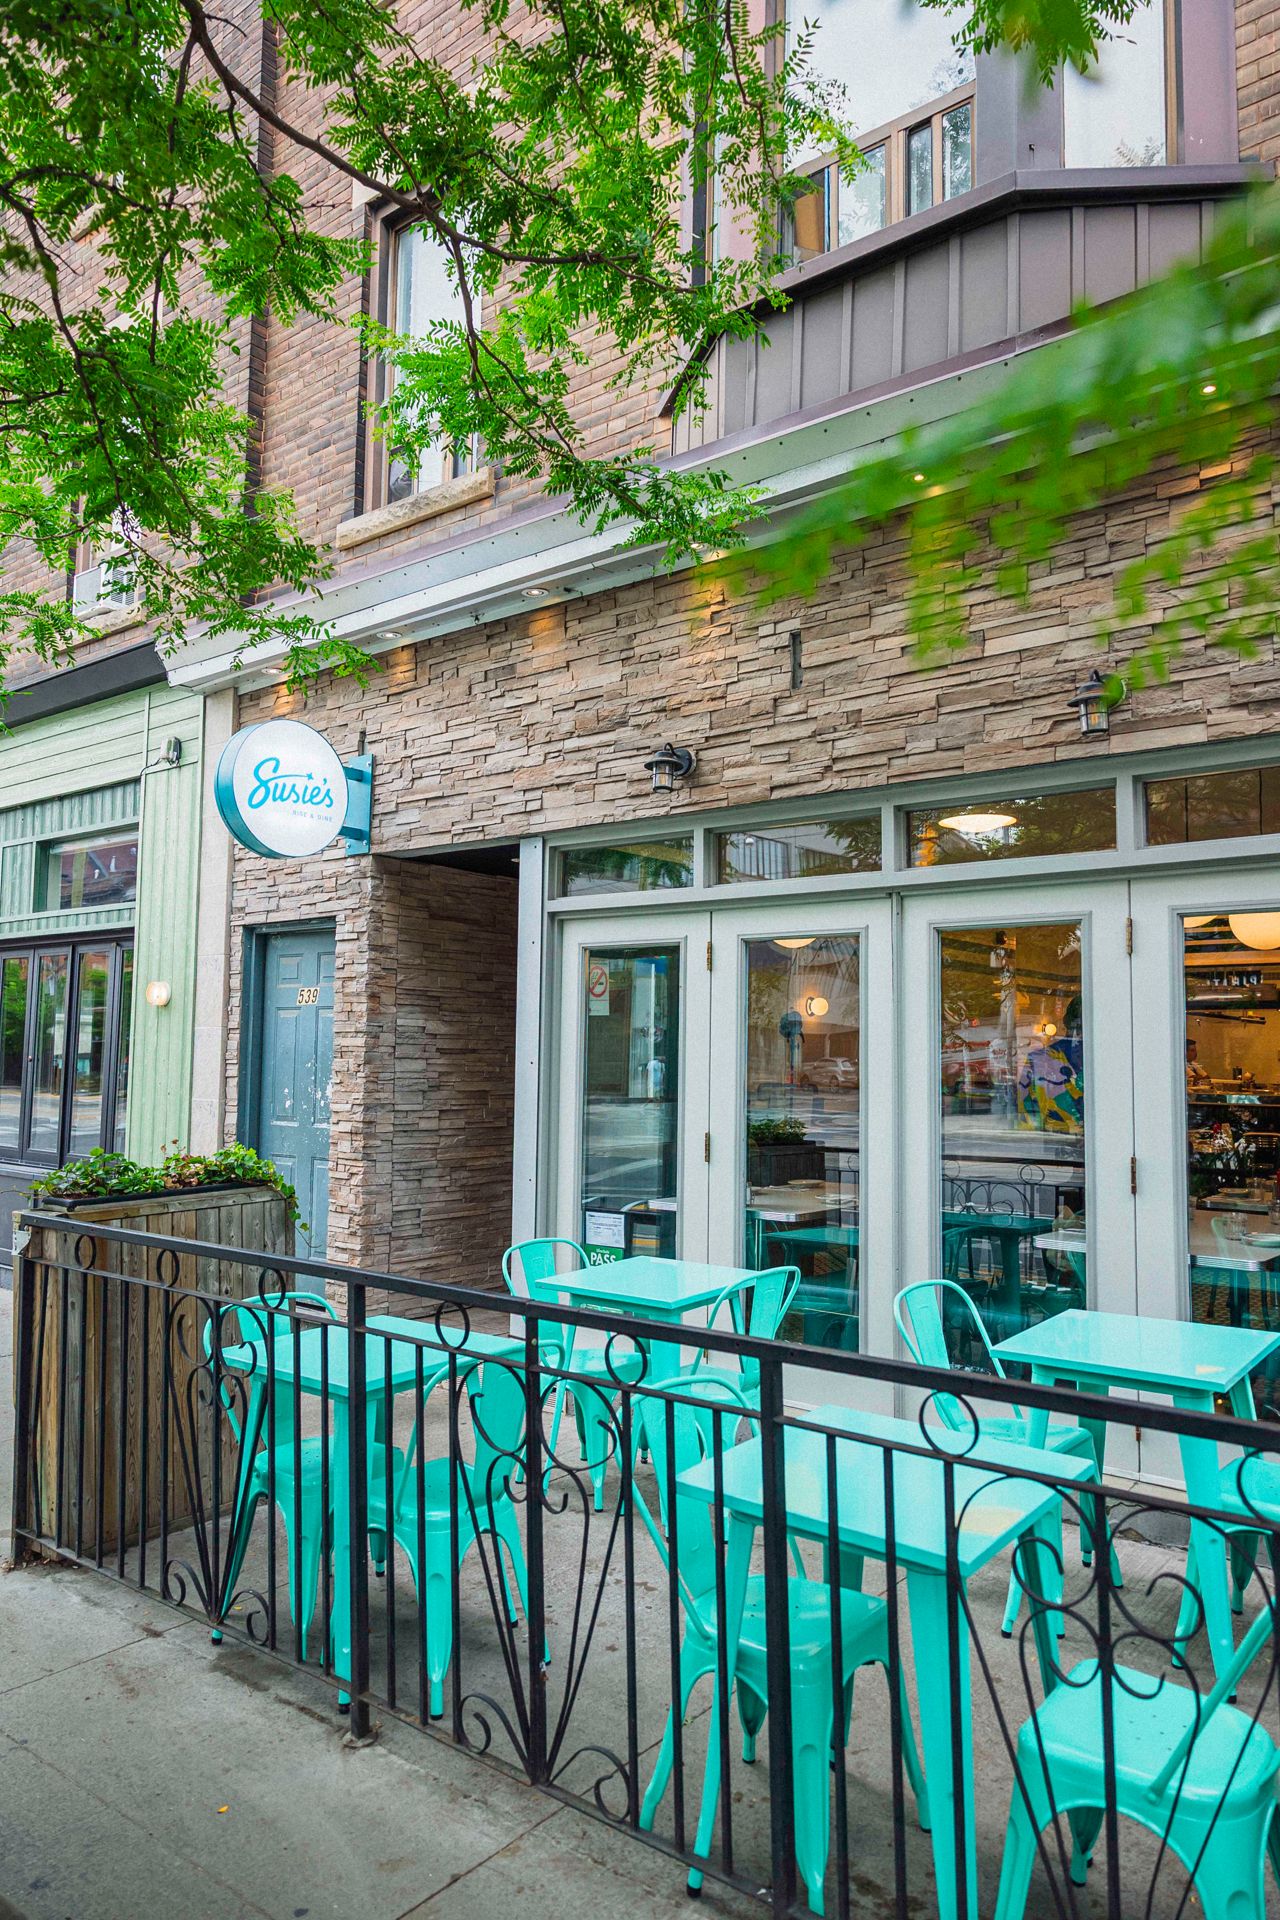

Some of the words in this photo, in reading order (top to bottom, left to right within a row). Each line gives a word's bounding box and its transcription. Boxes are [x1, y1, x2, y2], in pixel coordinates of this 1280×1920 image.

[248, 757, 333, 808] Susie's
[298, 989, 318, 1004] 539
[590, 1251, 616, 1265] PASS
